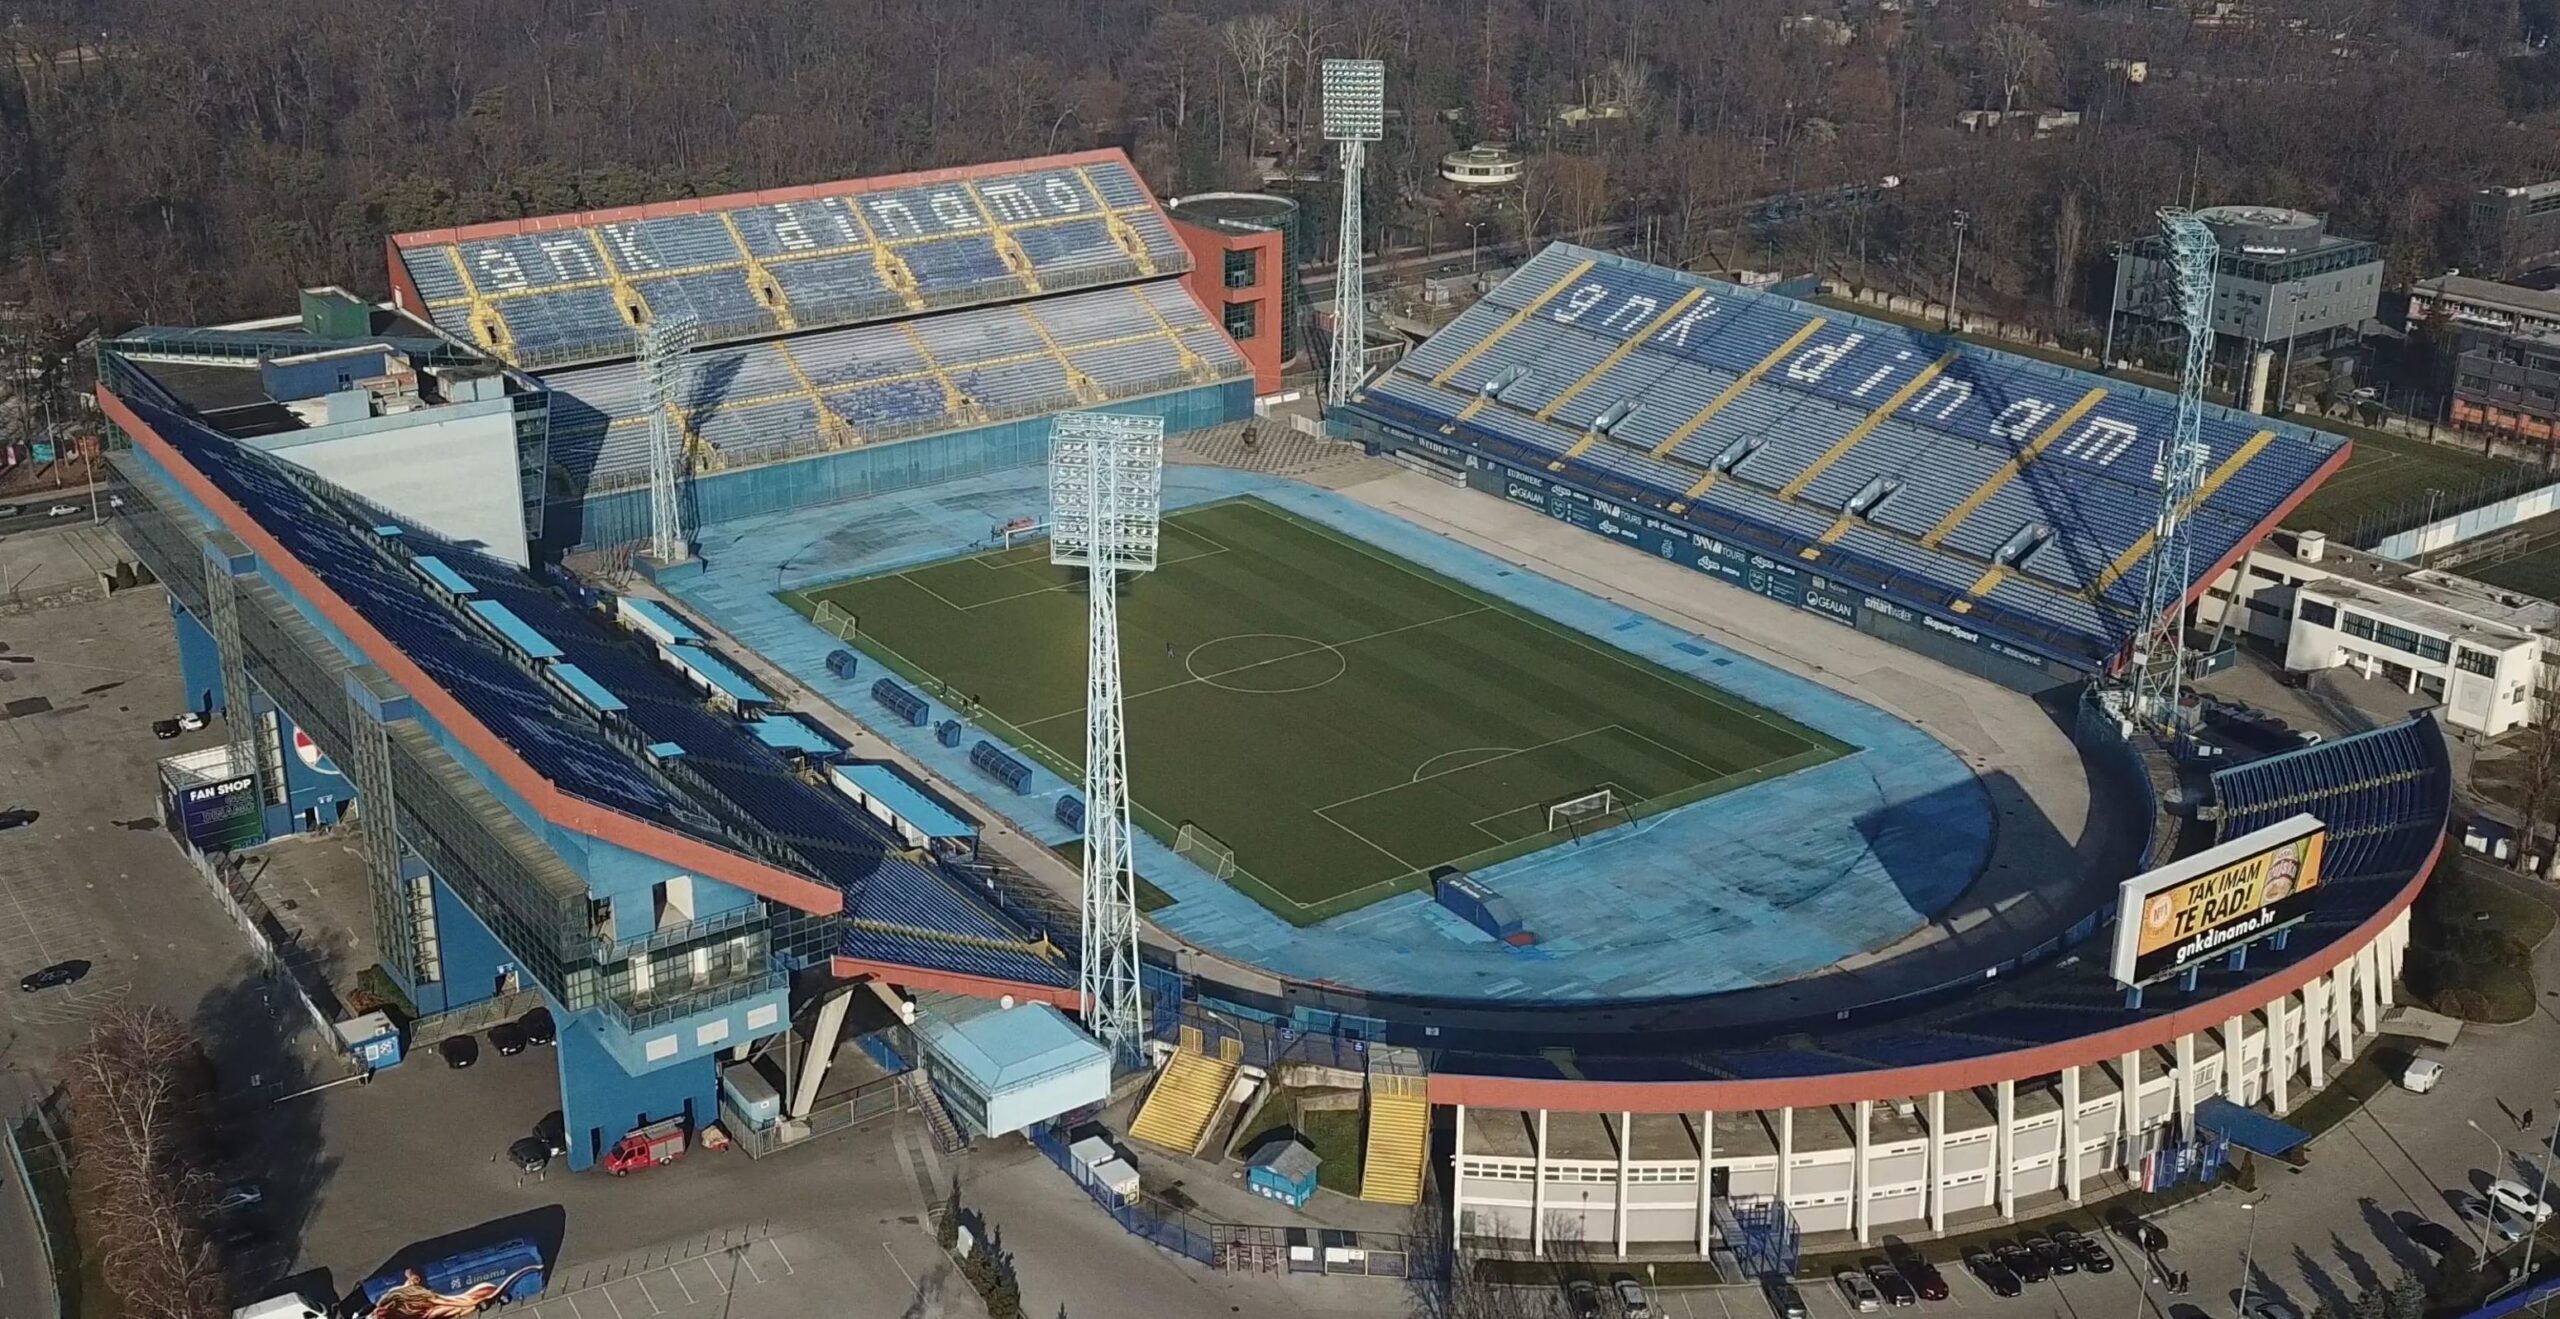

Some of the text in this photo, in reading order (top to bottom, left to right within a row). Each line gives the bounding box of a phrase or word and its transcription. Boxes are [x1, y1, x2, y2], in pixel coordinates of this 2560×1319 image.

[477, 178, 1081, 291] gnk dinamo
[1554, 284, 1721, 346] gnk
[1818, 597, 1852, 616] GEALAN
[1923, 616, 1980, 643] SuperSport
[190, 778, 252, 802] FAN SHOP
[2188, 860, 2263, 906] TAK IMAM
[2174, 883, 2254, 938] TE RAD!
[2176, 907, 2277, 965] gnkdinamo.hr
[465, 1268, 507, 1285] dinamo
